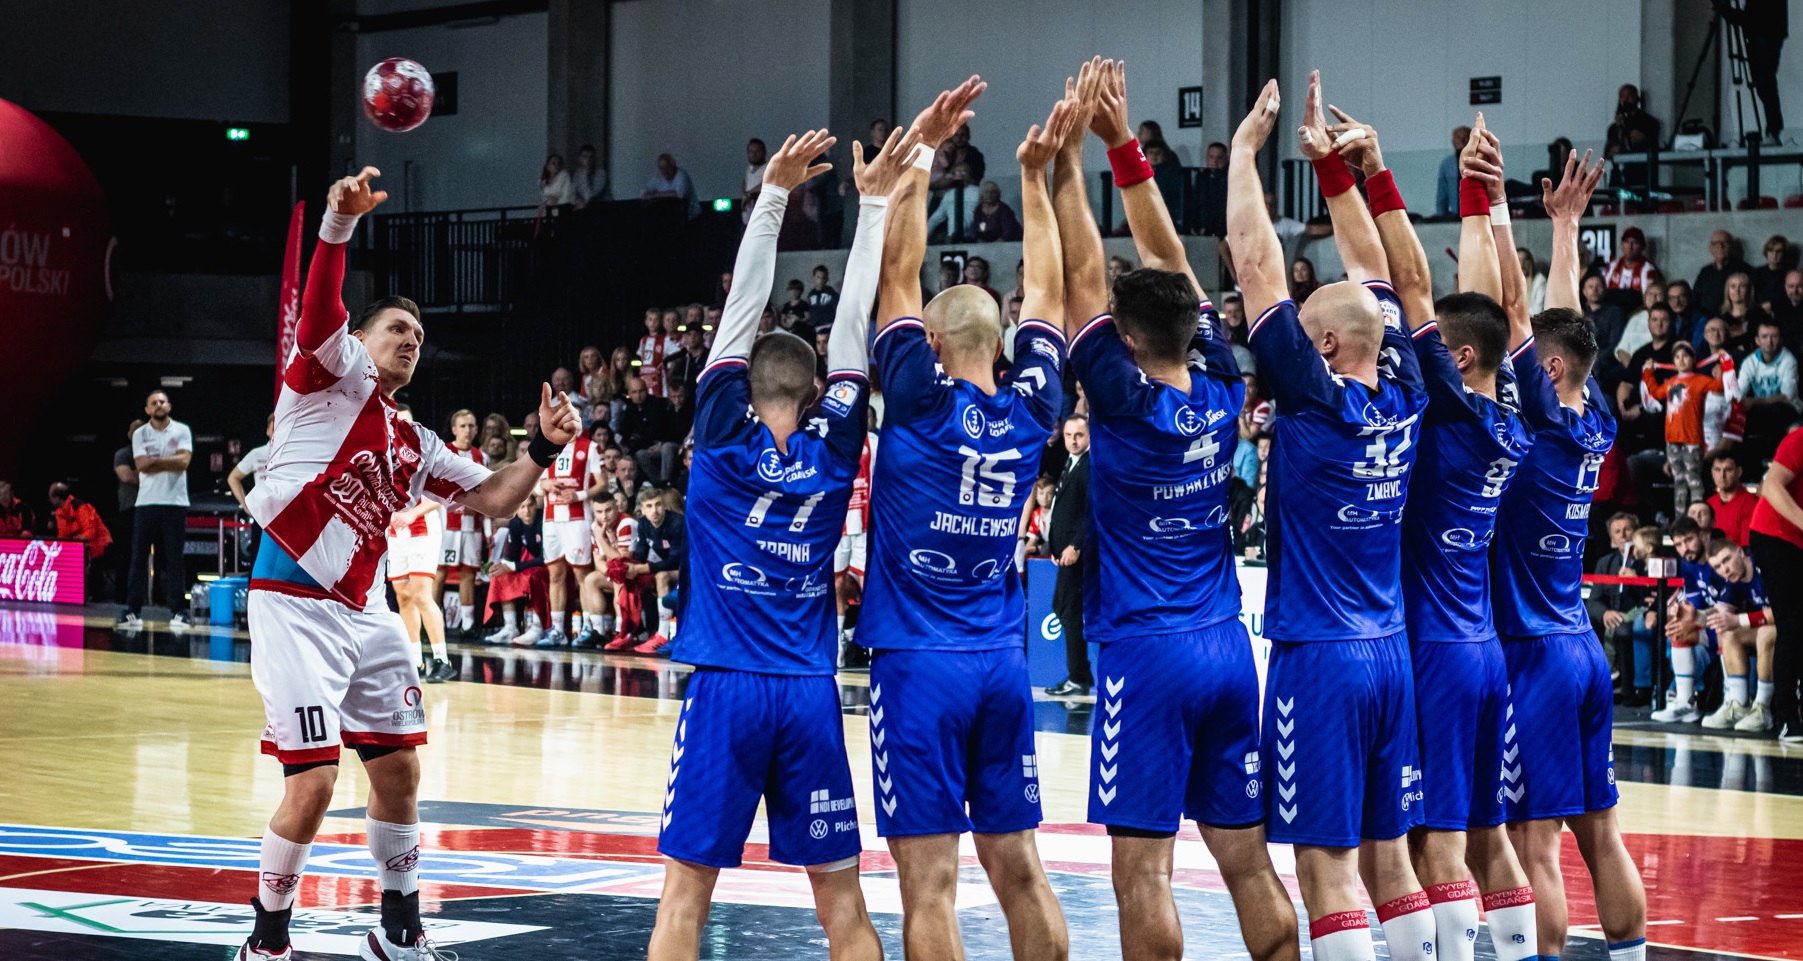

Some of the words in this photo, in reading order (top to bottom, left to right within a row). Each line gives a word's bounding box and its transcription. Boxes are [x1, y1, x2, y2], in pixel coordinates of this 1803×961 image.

[1184, 92, 1201, 119] 14
[1183, 430, 1220, 469] 4
[557, 457, 570, 471] 31
[958, 444, 1022, 508] 15
[930, 511, 1017, 537] JACHLEWSKI
[445, 550, 457, 563] 23
[295, 705, 328, 743] 10
